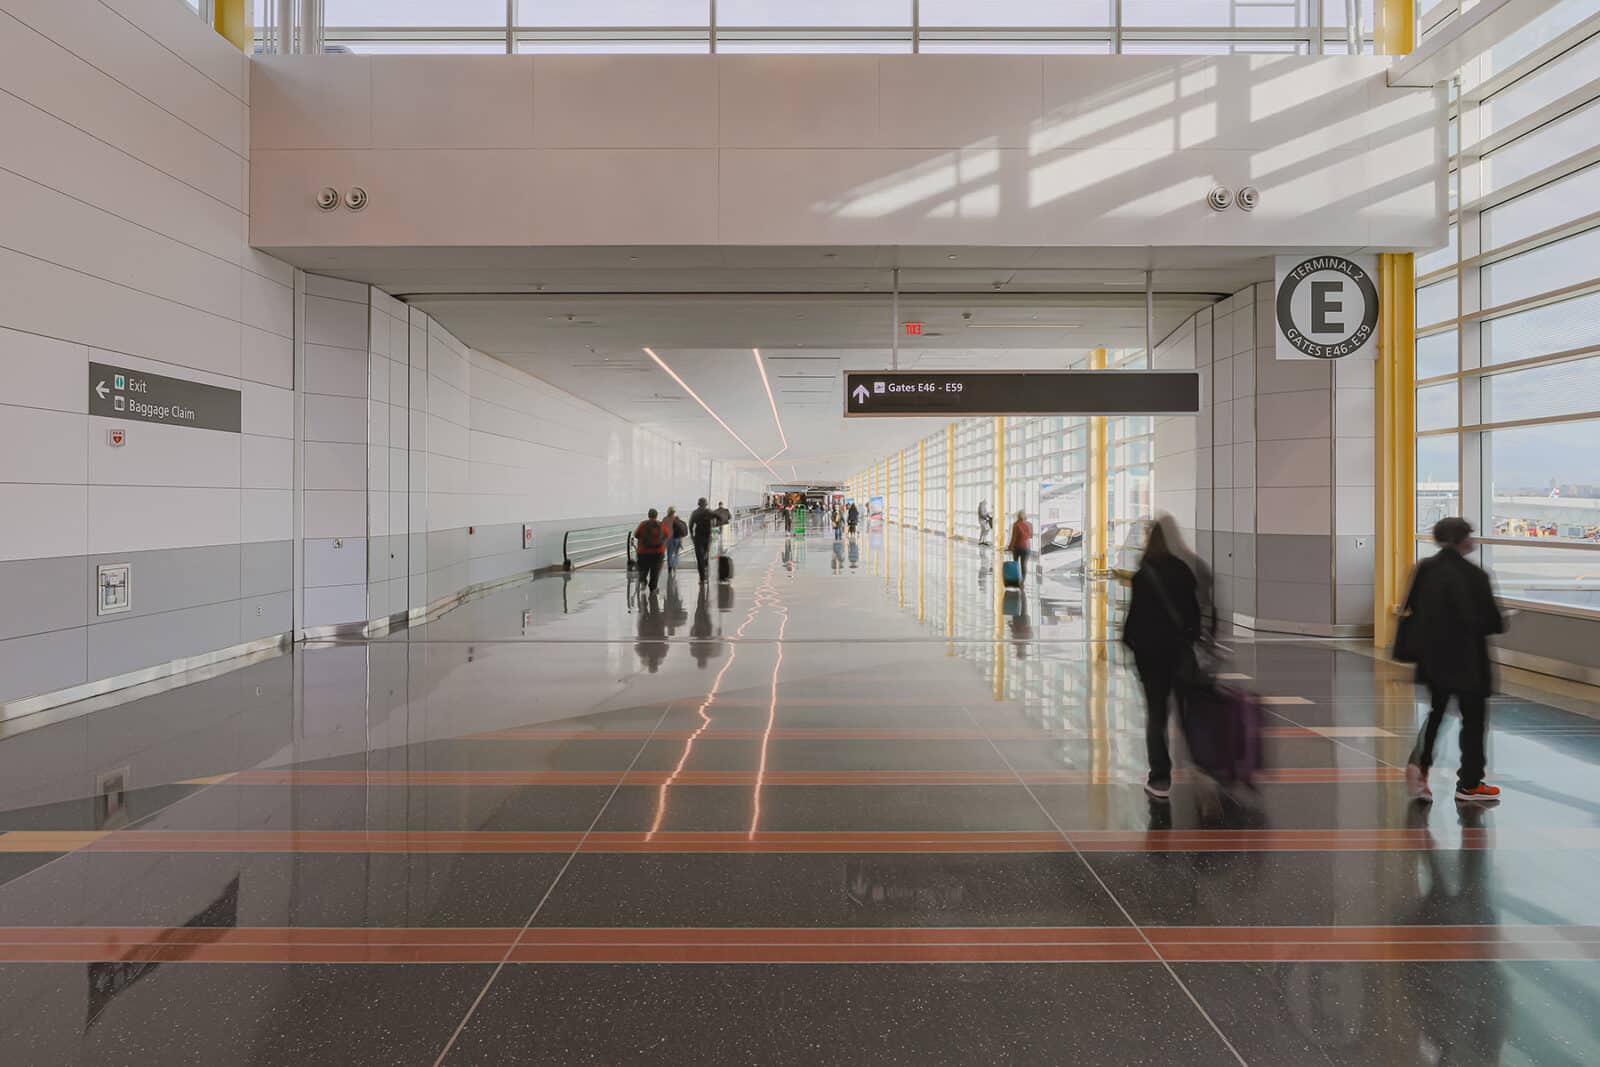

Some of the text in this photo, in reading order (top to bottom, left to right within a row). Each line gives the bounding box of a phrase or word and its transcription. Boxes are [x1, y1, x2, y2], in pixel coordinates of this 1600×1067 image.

[1290, 258, 1364, 281] TERMINAL 2
[1311, 281, 1345, 334] E
[1287, 328, 1321, 356] GATES
[129, 378, 147, 393] Exit
[888, 383, 916, 393] Gates
[918, 383, 935, 392] E46
[945, 383, 963, 392] E59
[129, 399, 195, 420] Baggage Claim
